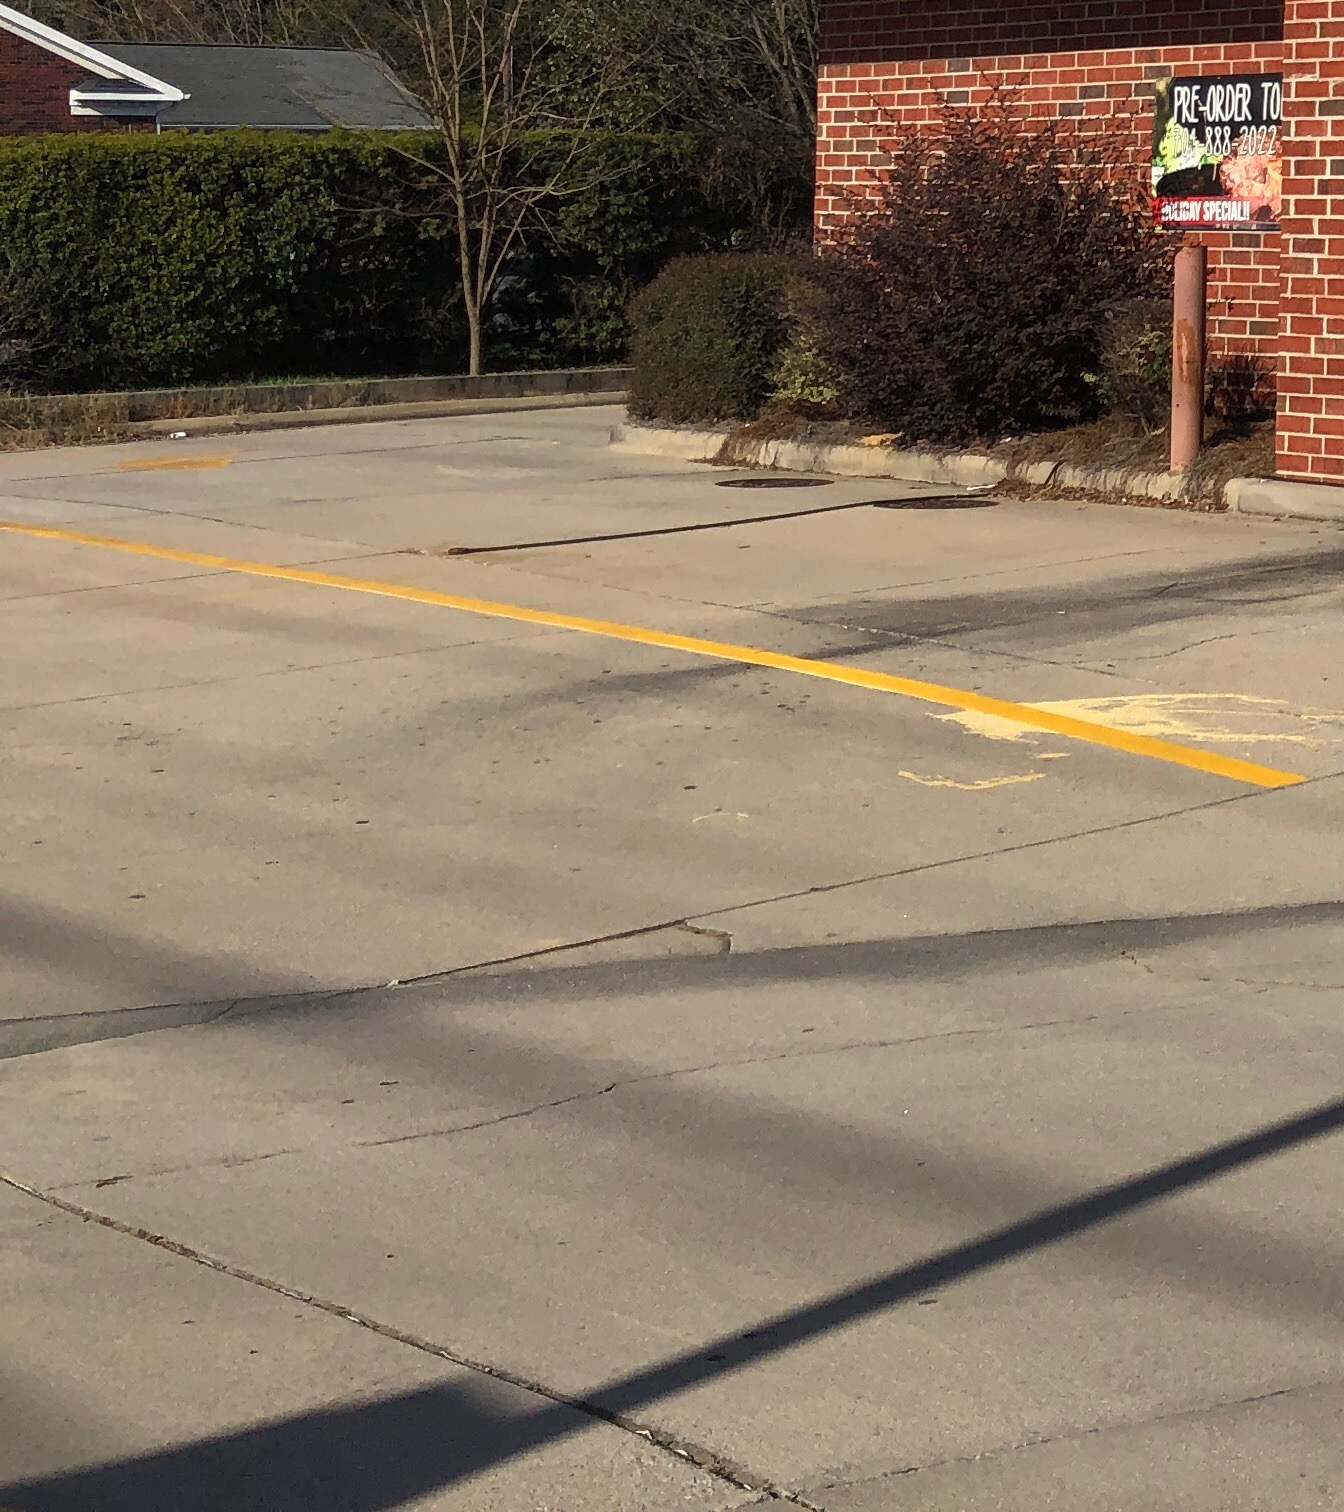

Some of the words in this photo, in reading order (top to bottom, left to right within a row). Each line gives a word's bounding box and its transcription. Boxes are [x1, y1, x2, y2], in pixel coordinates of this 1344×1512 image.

[1174, 83, 1252, 123] PRE-ORDER
[1173, 125, 1277, 157] 704-888-2022
[1203, 200, 1250, 221] SPECIAL!!
